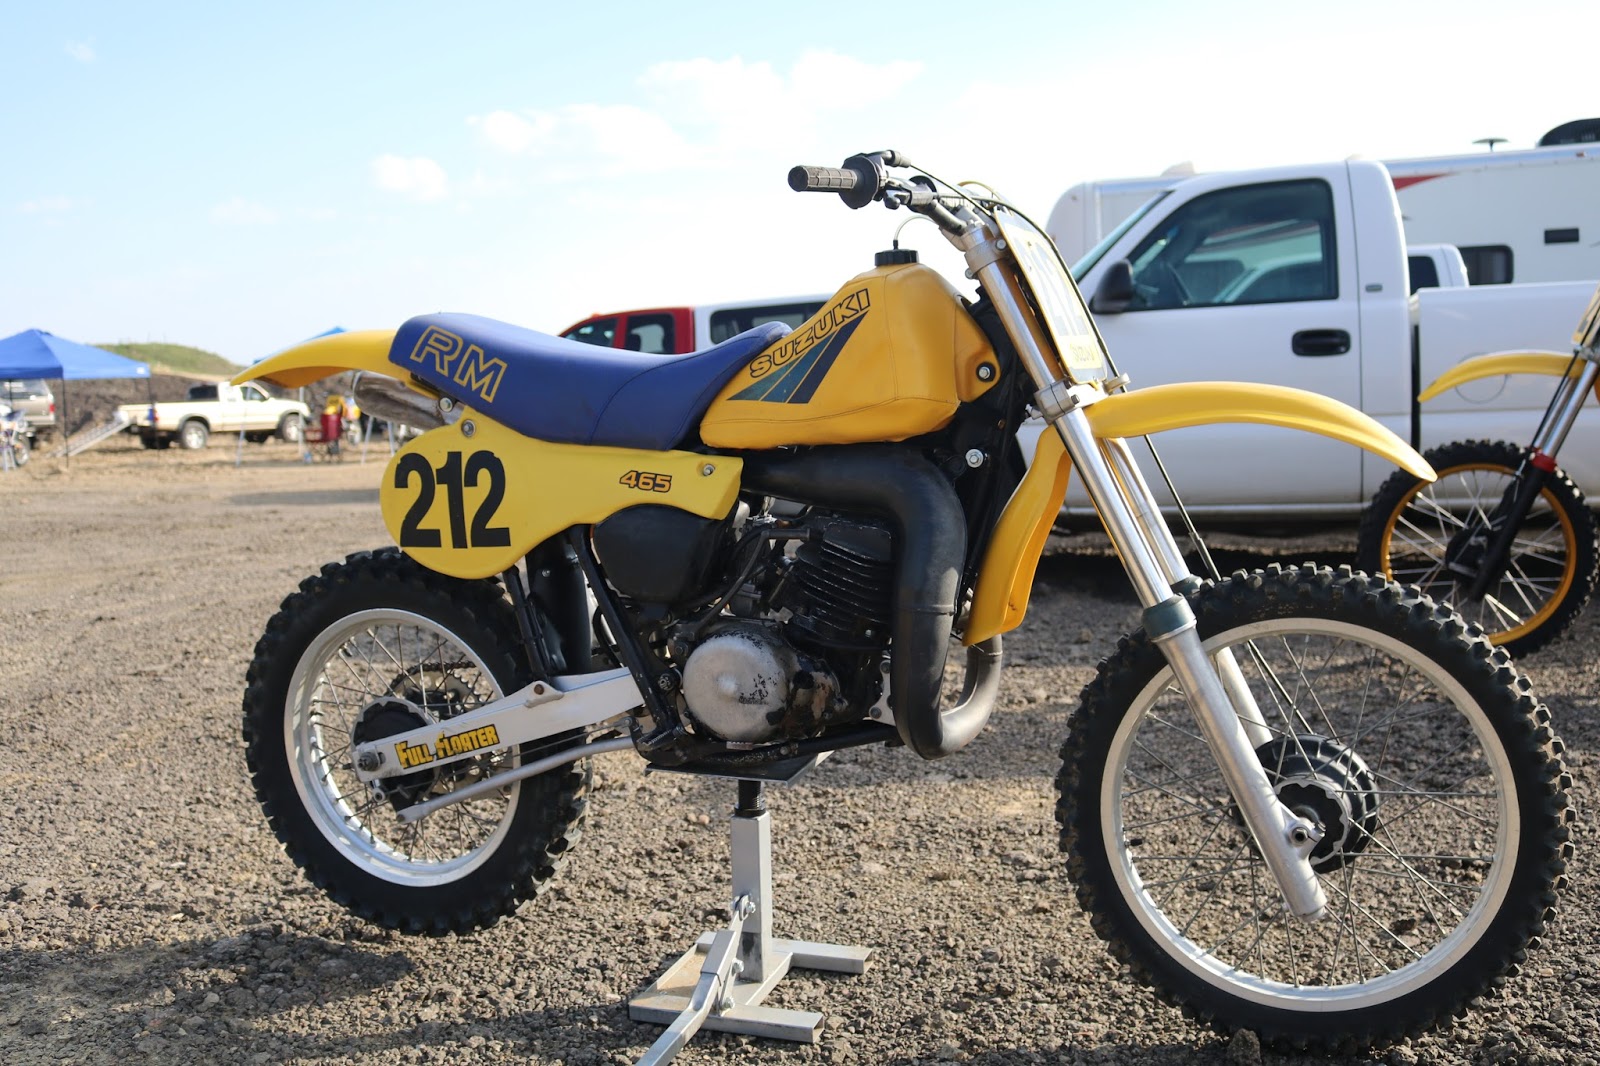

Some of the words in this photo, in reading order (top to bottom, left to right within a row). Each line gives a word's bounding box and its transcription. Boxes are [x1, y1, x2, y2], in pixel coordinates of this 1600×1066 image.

[410, 325, 508, 403] RM
[749, 287, 871, 378] SUZUKI
[394, 450, 511, 549] 212
[619, 470, 672, 493] 465
[394, 740, 435, 770] FULL
[434, 731, 500, 760] FLOATER
